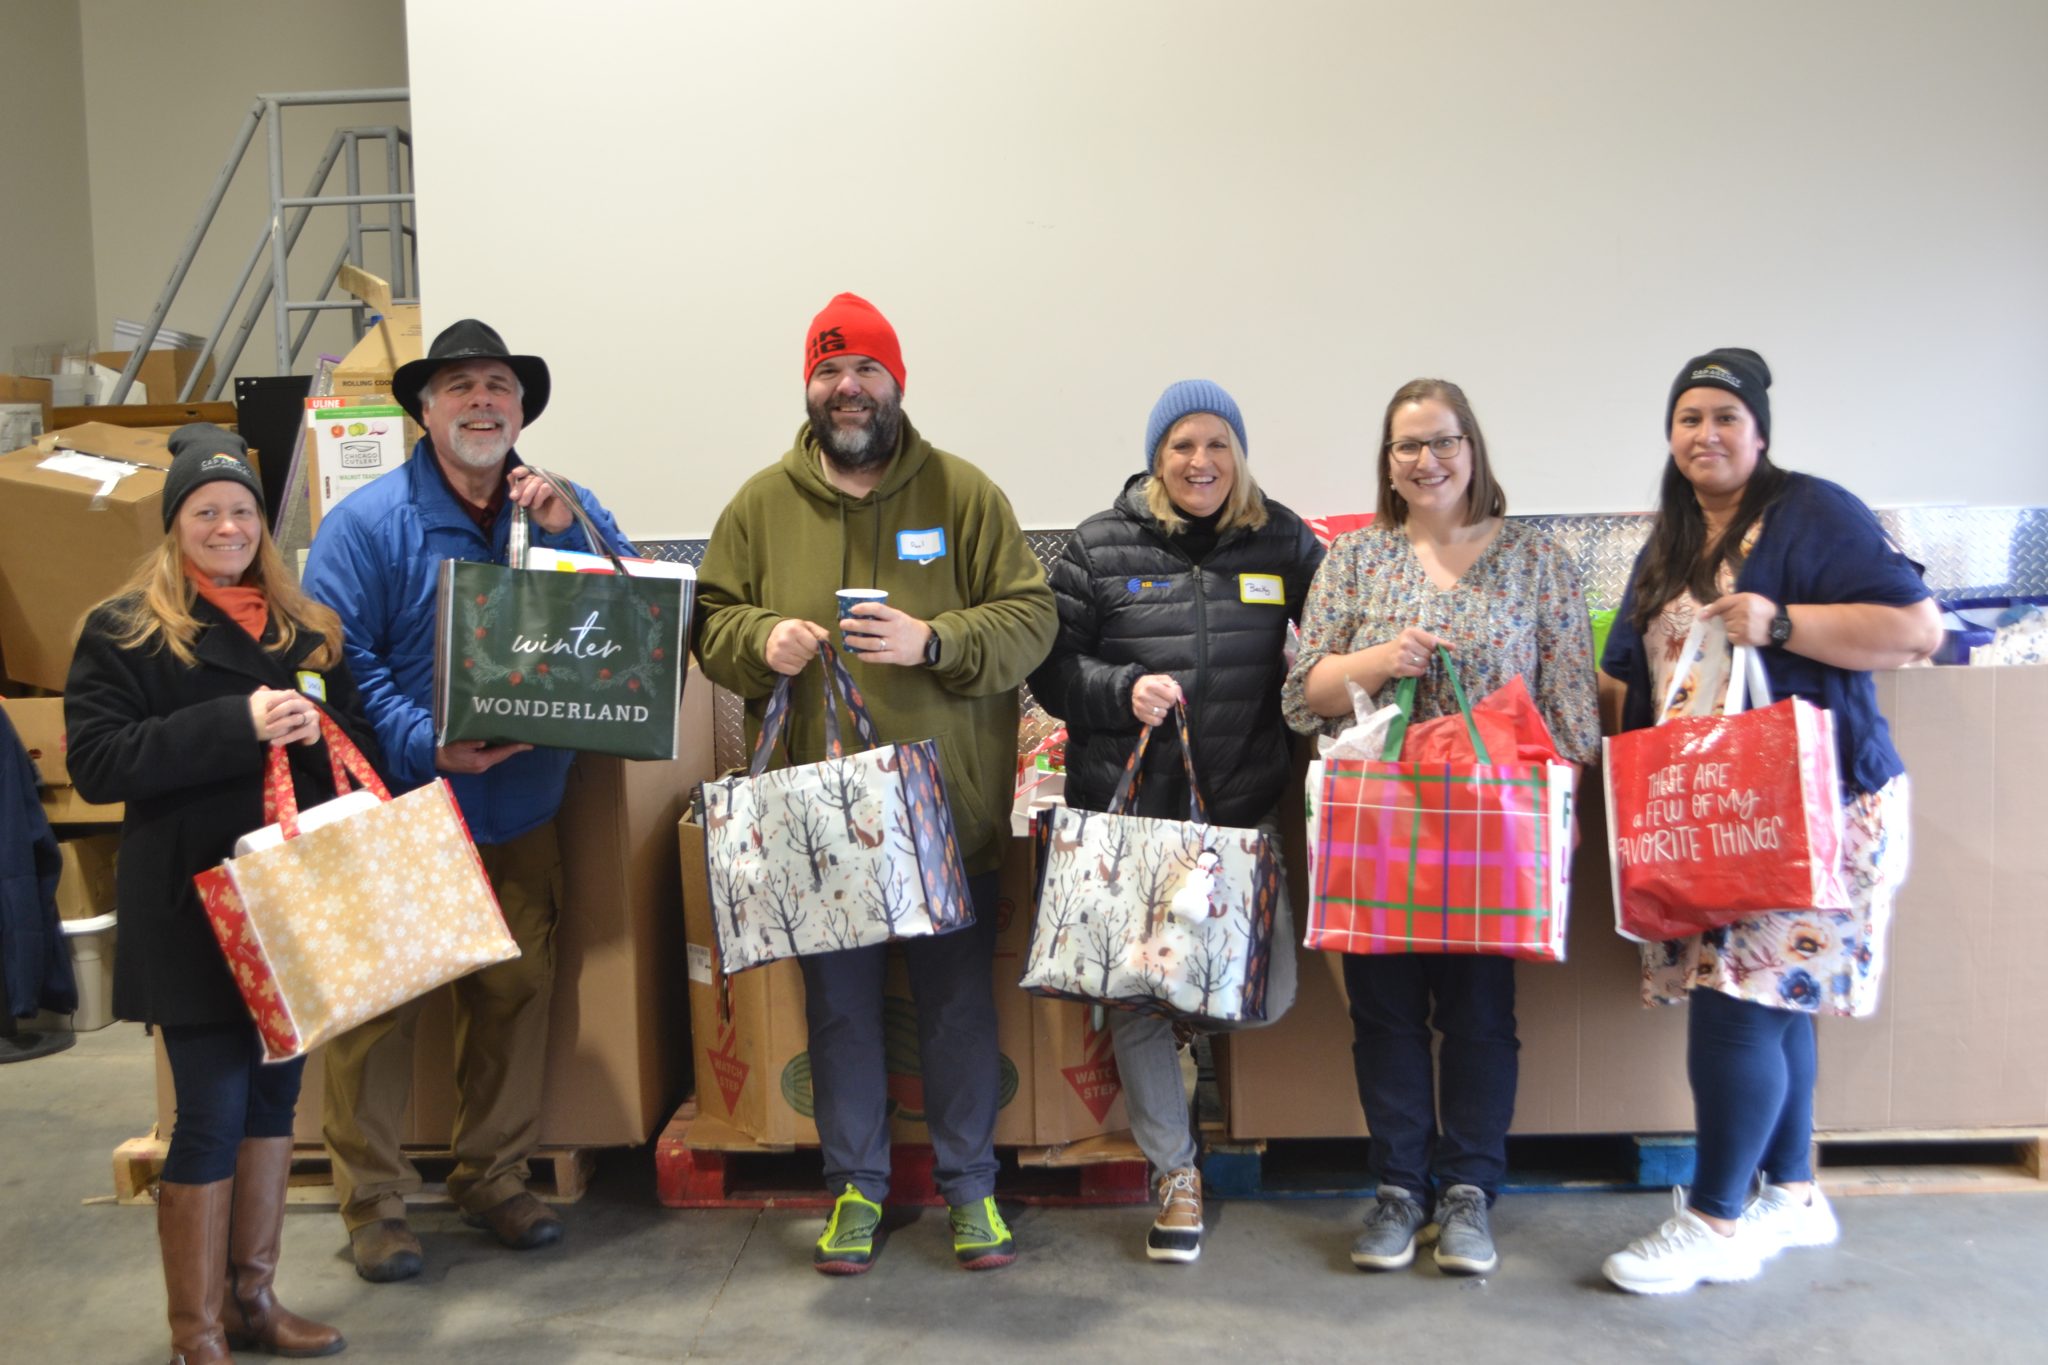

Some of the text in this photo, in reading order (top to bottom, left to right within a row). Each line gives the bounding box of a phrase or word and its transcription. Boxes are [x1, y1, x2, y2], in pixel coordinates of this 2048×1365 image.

[342, 379, 373, 387] ROLLING
[312, 399, 340, 408] ULINE
[511, 610, 622, 659] winter
[472, 696, 649, 723] WONDERLAND
[1647, 762, 1731, 800] THESE ARE
[1645, 798, 1683, 828] FEW
[1691, 792, 1715, 819] OF
[713, 1057, 743, 1083] WATCH
[719, 1075, 739, 1093] STEP
[1083, 1082, 1117, 1100] STEP
